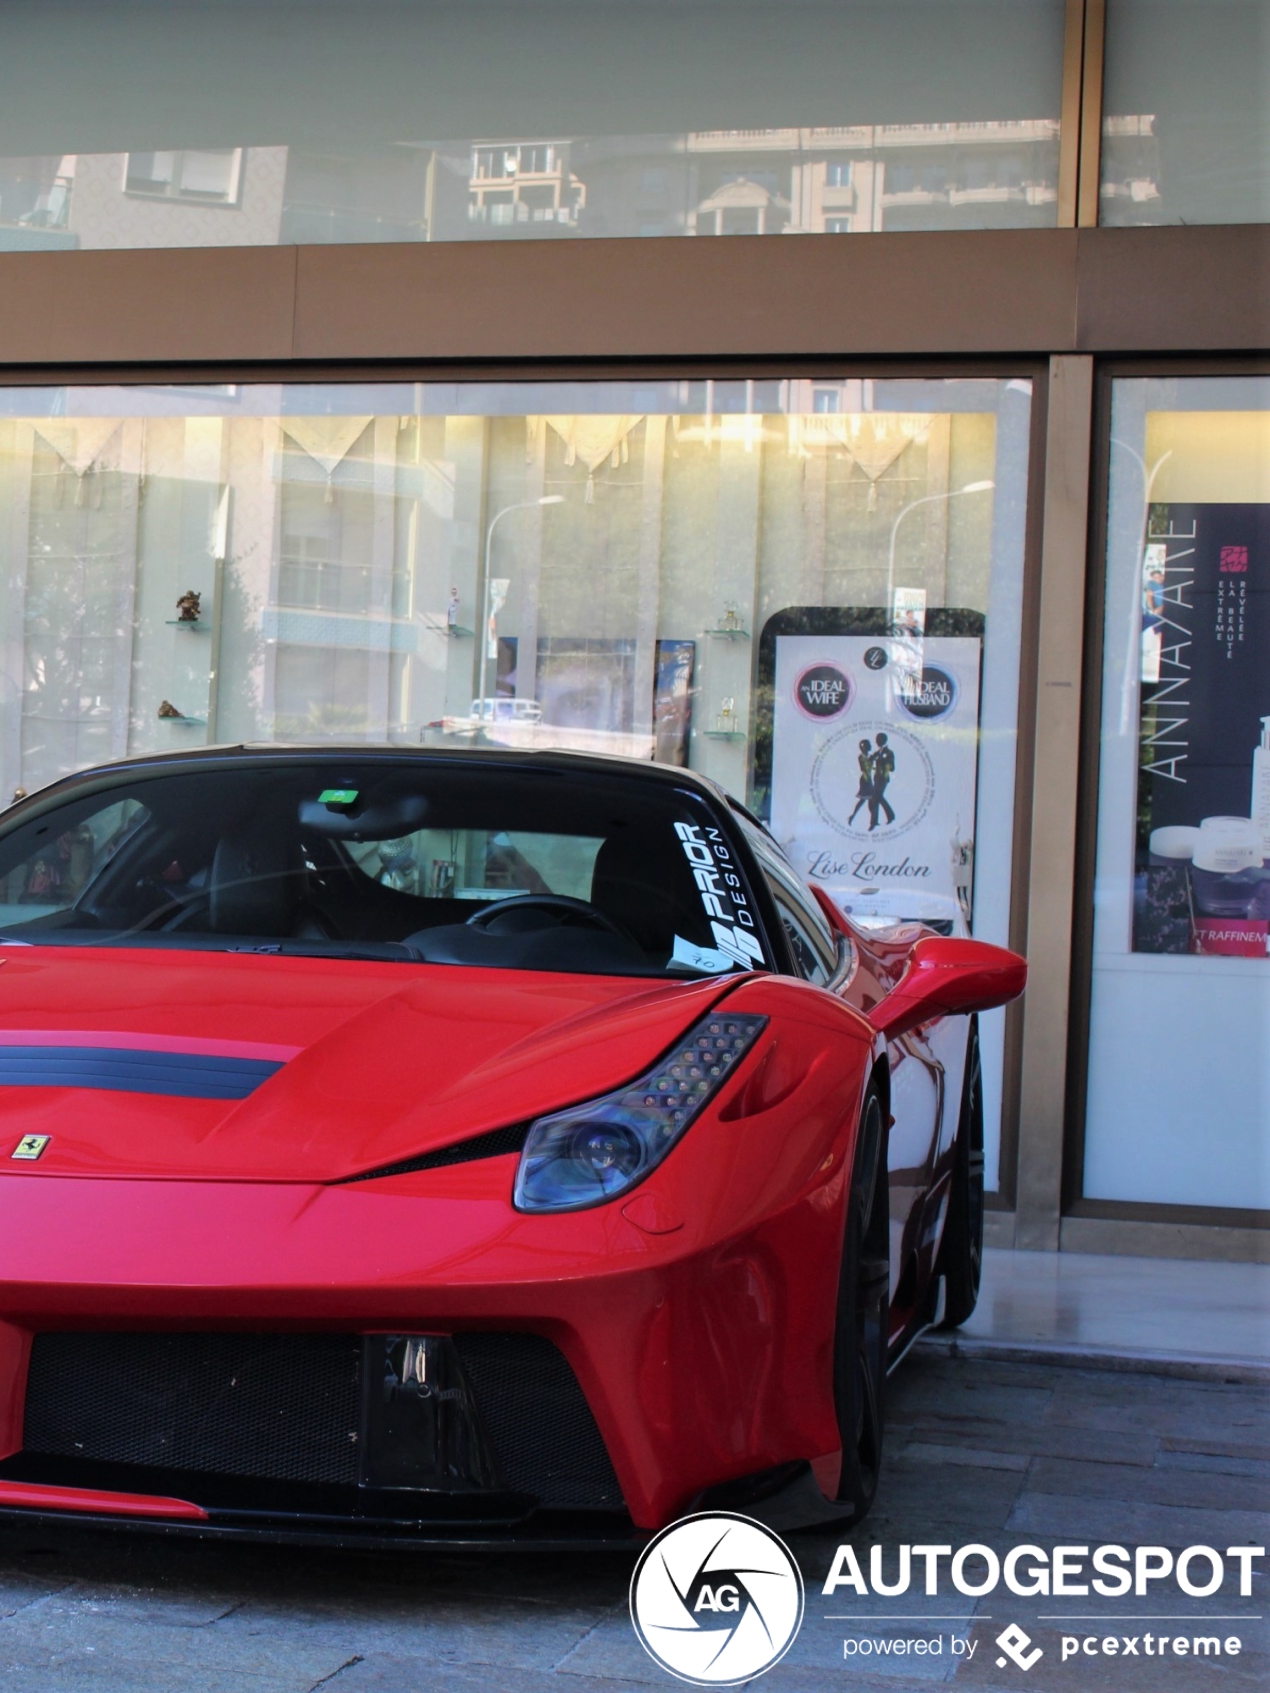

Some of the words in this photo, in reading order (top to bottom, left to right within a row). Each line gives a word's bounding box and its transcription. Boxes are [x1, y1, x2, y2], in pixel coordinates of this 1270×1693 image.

[1141, 519, 1196, 783] ANNAYAKE
[811, 680, 845, 692] IDEAL
[916, 681, 950, 693] IDEAL
[806, 692, 840, 705] WIFE
[904, 693, 950, 706] HUSBAND
[673, 821, 734, 921] PRIOR
[807, 851, 849, 880] Lise
[851, 852, 931, 881] London
[705, 827, 754, 927] DESIGN
